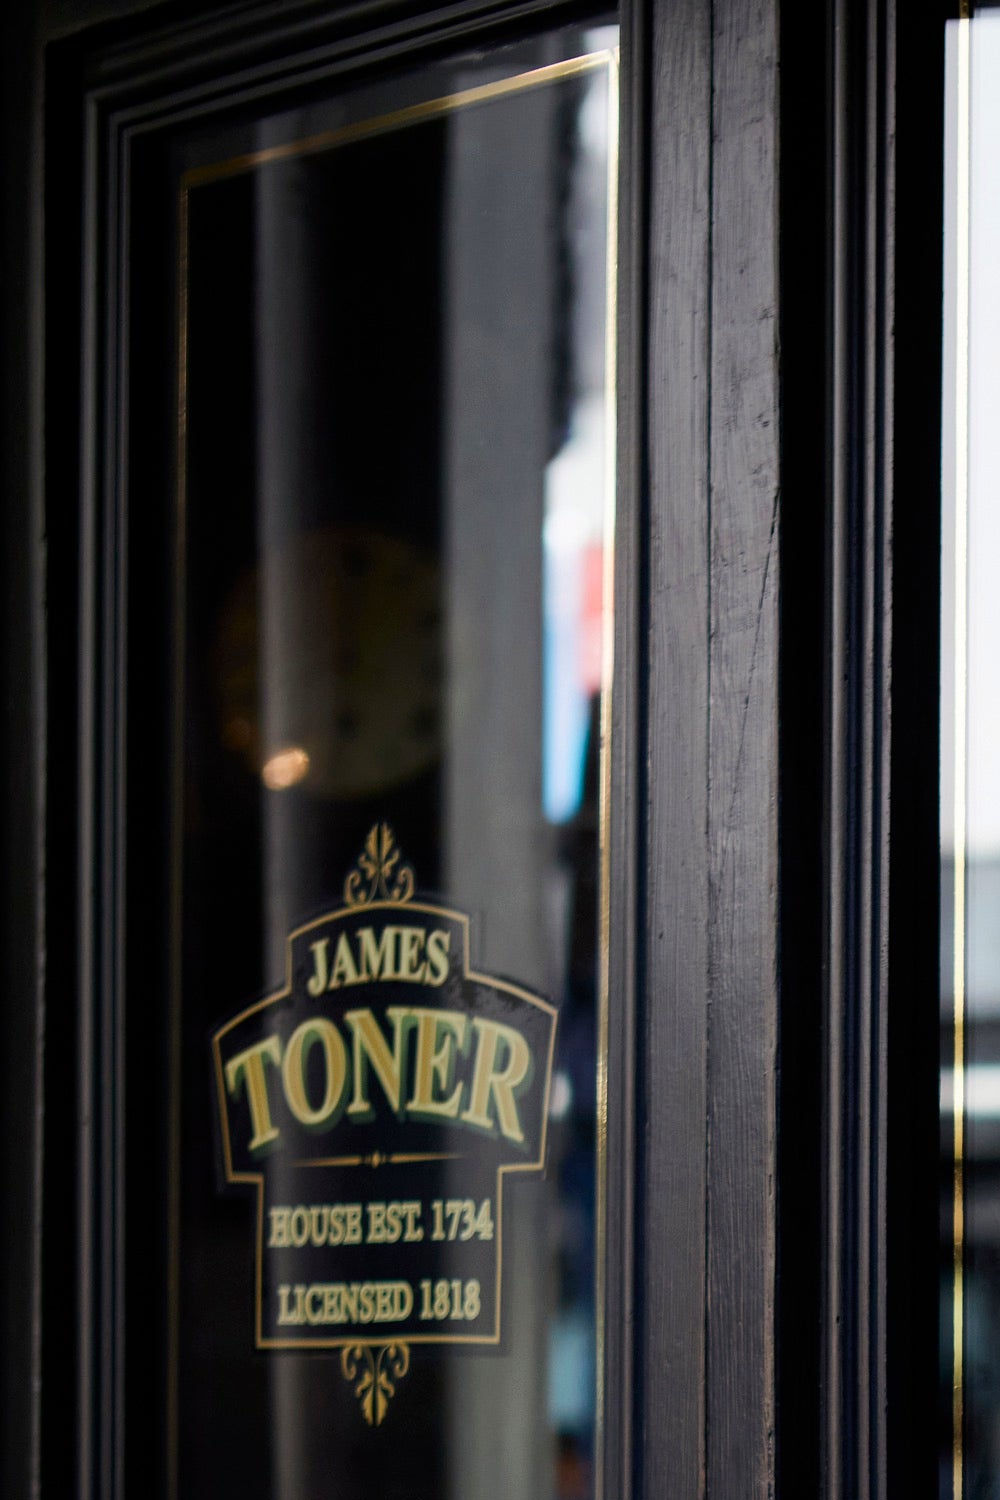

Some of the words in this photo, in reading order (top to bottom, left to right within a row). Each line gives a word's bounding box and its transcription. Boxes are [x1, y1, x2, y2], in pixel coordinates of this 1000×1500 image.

[307, 926, 451, 996] JAMES
[226, 1006, 530, 1150] TONER
[268, 1205, 362, 1247] HOUSE
[367, 1203, 424, 1244] EST.
[431, 1199, 494, 1241] 1734
[277, 1281, 414, 1325] LICENSED
[419, 1280, 481, 1321] 1818
